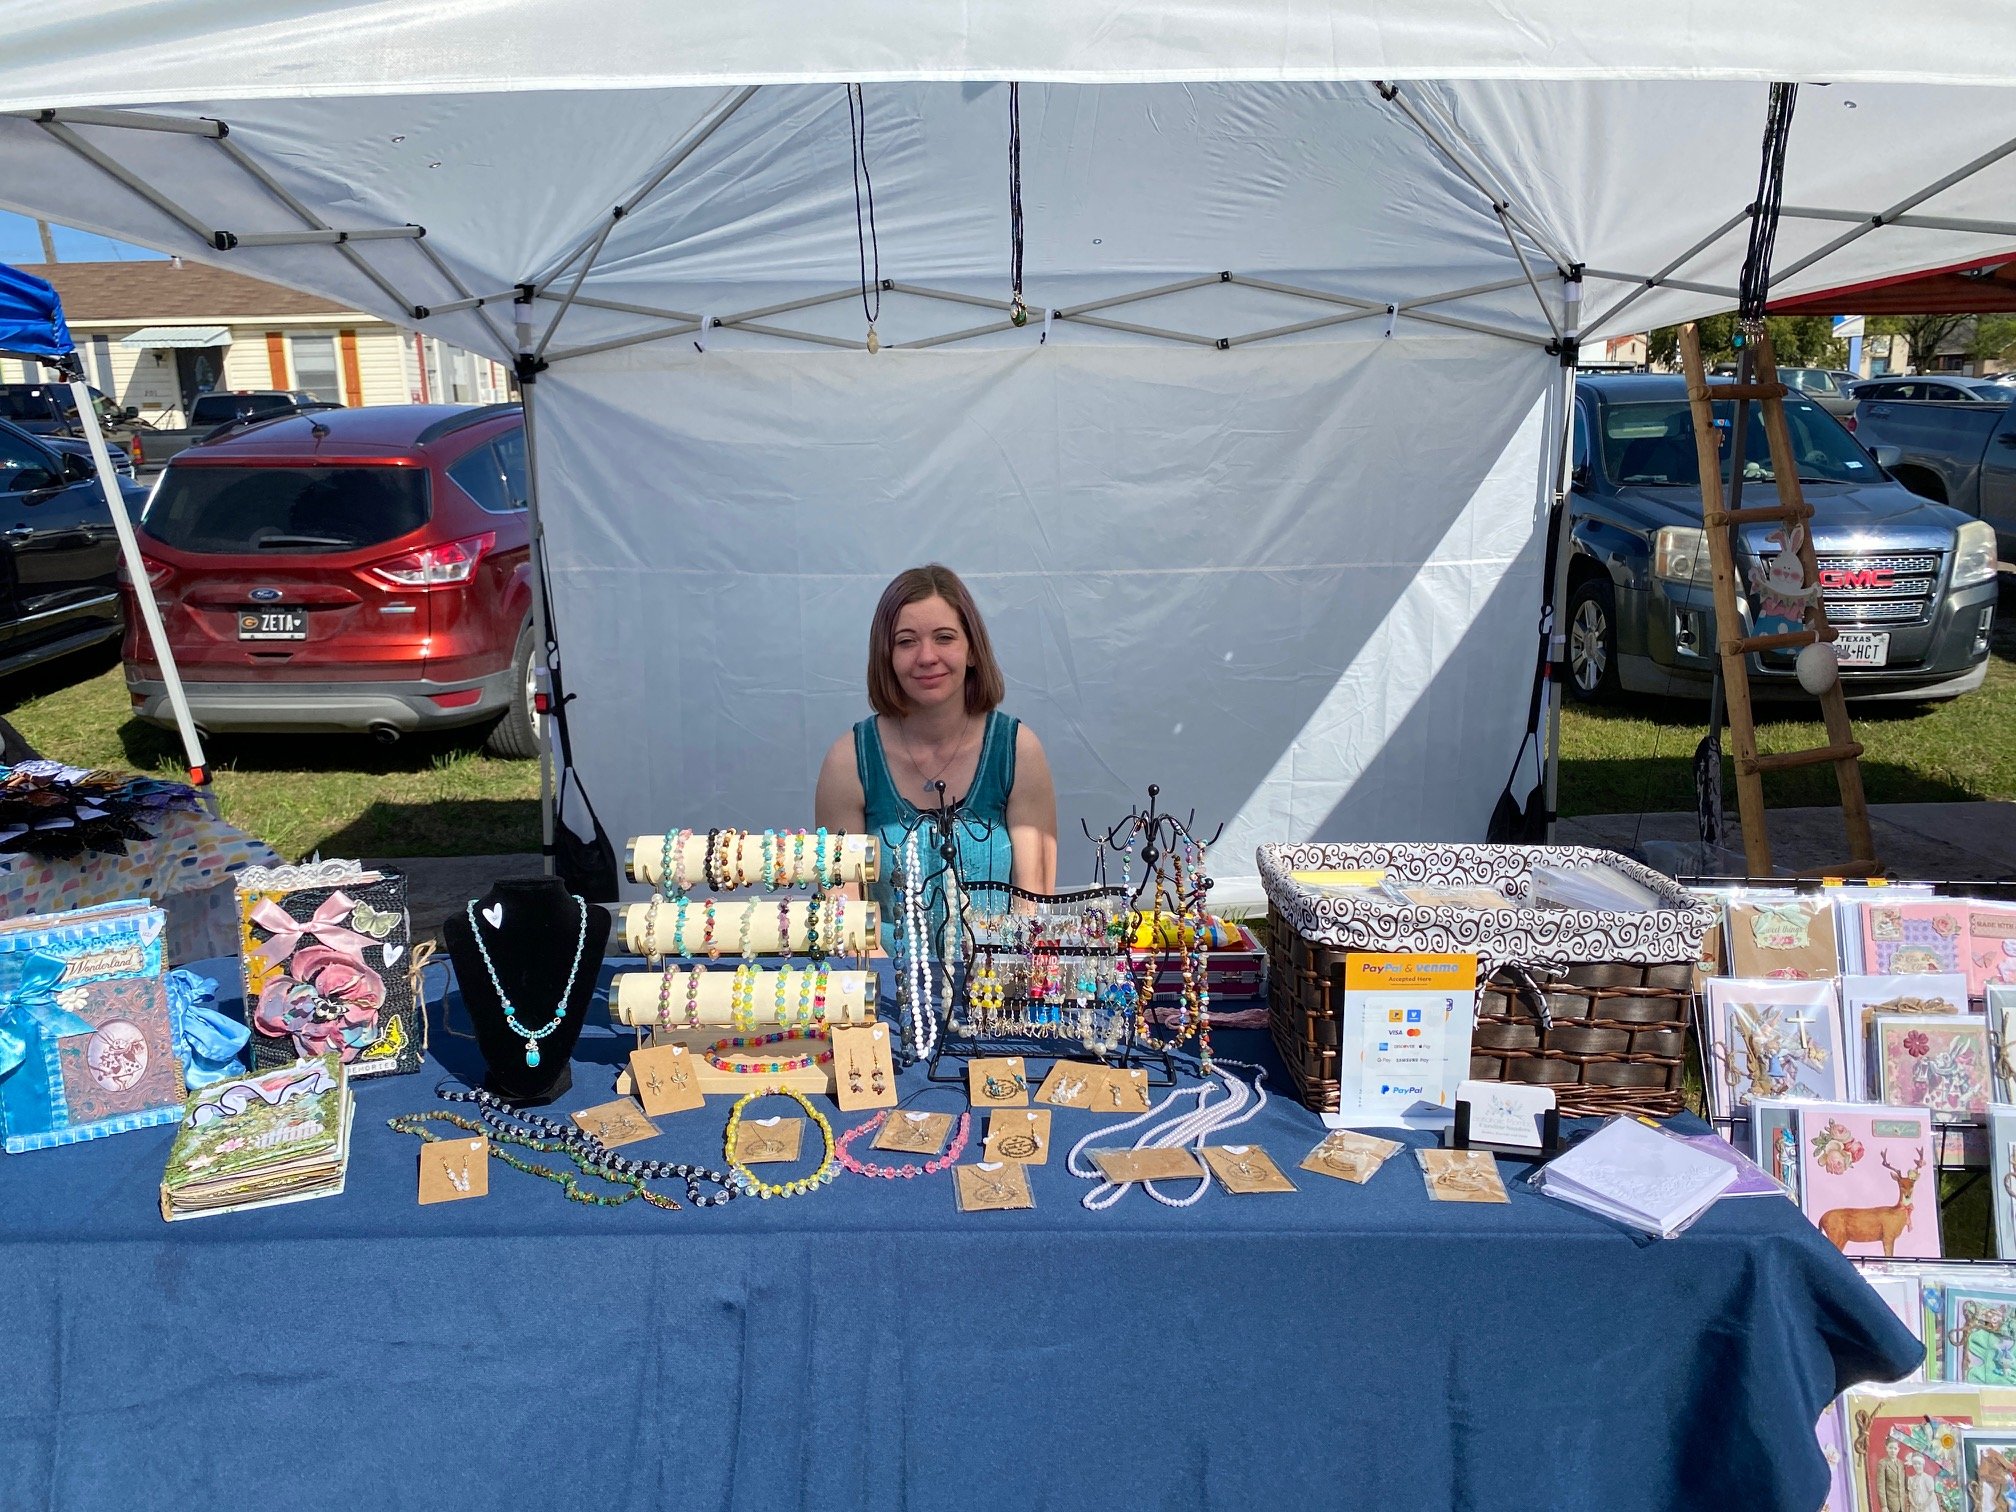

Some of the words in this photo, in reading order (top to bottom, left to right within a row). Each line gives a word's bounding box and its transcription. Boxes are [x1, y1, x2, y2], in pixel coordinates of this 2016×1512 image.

[1820, 569, 1894, 587] GMC
[262, 615, 293, 631] ZETA
[1840, 635, 1871, 643] TEXAS
[66, 954, 132, 975] Wonderland
[1362, 963, 1402, 974] PayPal
[1405, 964, 1412, 973] &
[1416, 963, 1459, 973] venmo
[1393, 1087, 1423, 1095] PayPal
